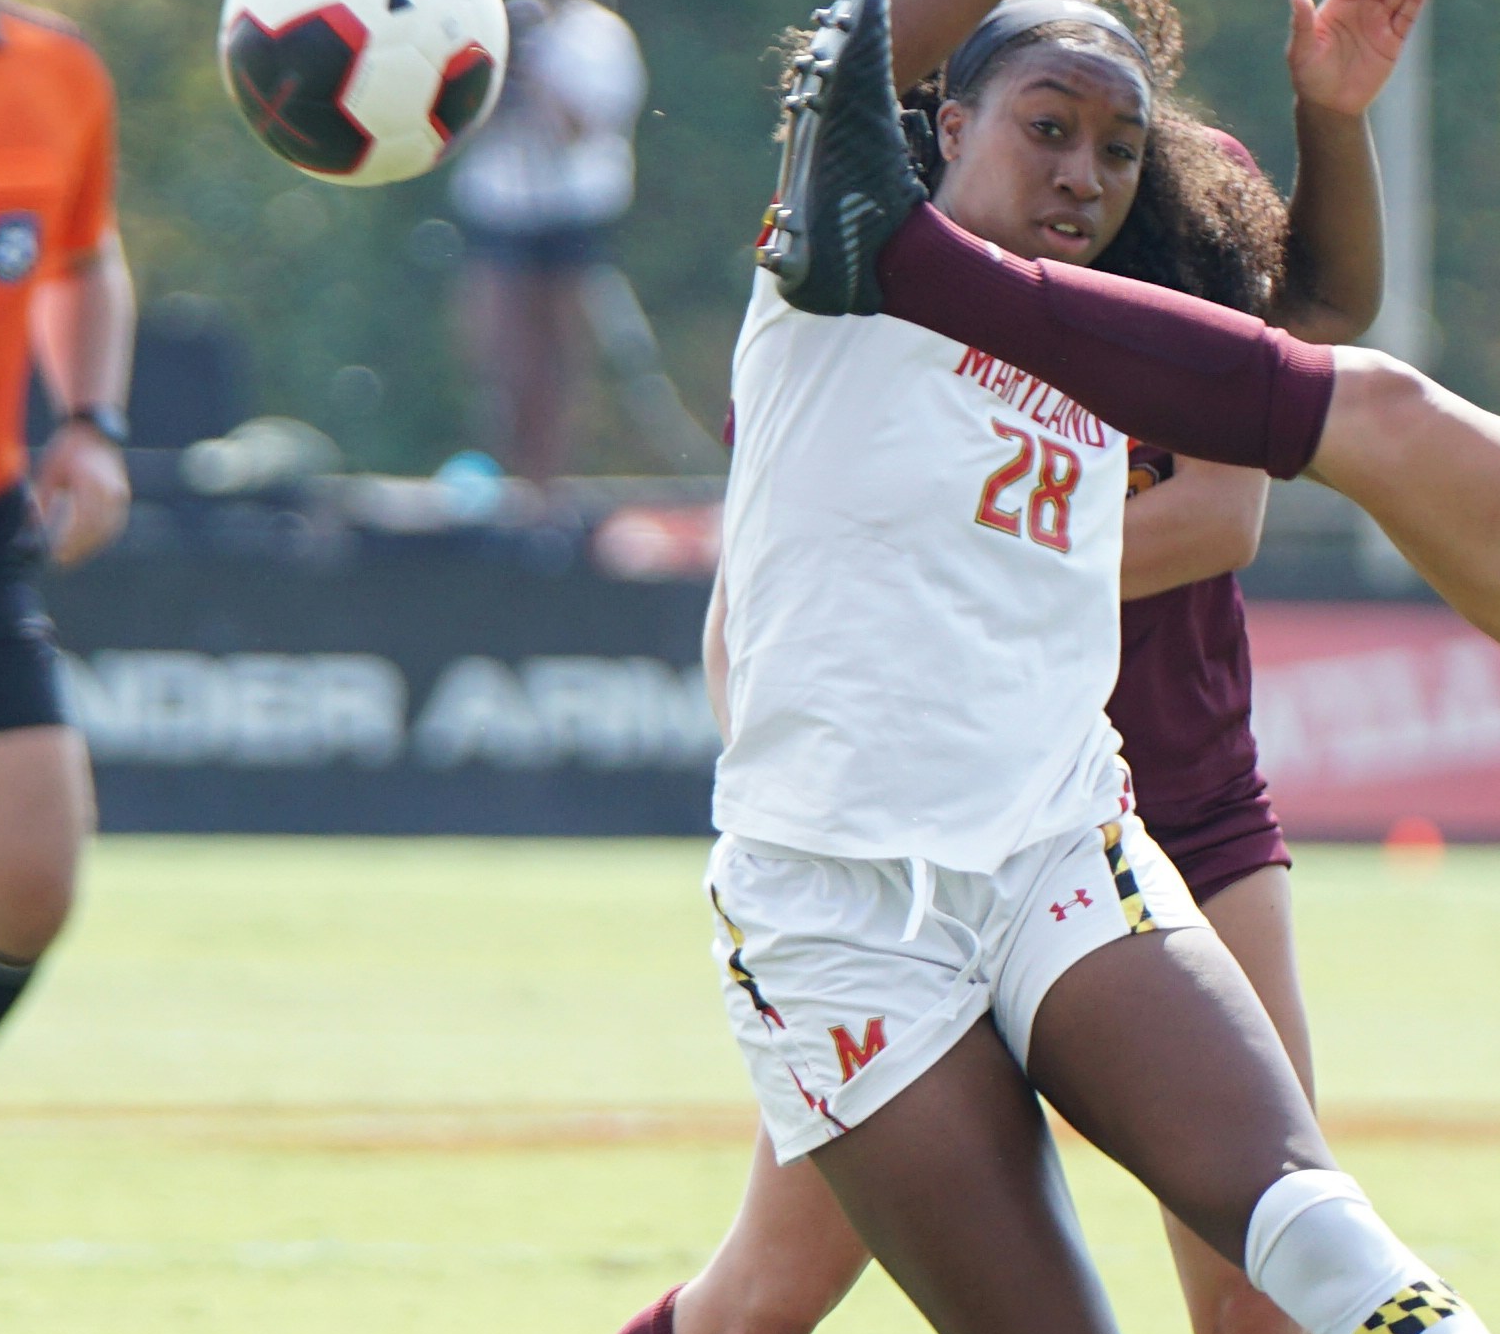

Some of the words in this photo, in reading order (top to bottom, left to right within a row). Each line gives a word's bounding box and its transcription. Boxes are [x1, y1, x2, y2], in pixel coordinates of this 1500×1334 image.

[974, 417, 1082, 554] 28
[53, 647, 406, 765] NDER
[828, 1016, 888, 1083] M
